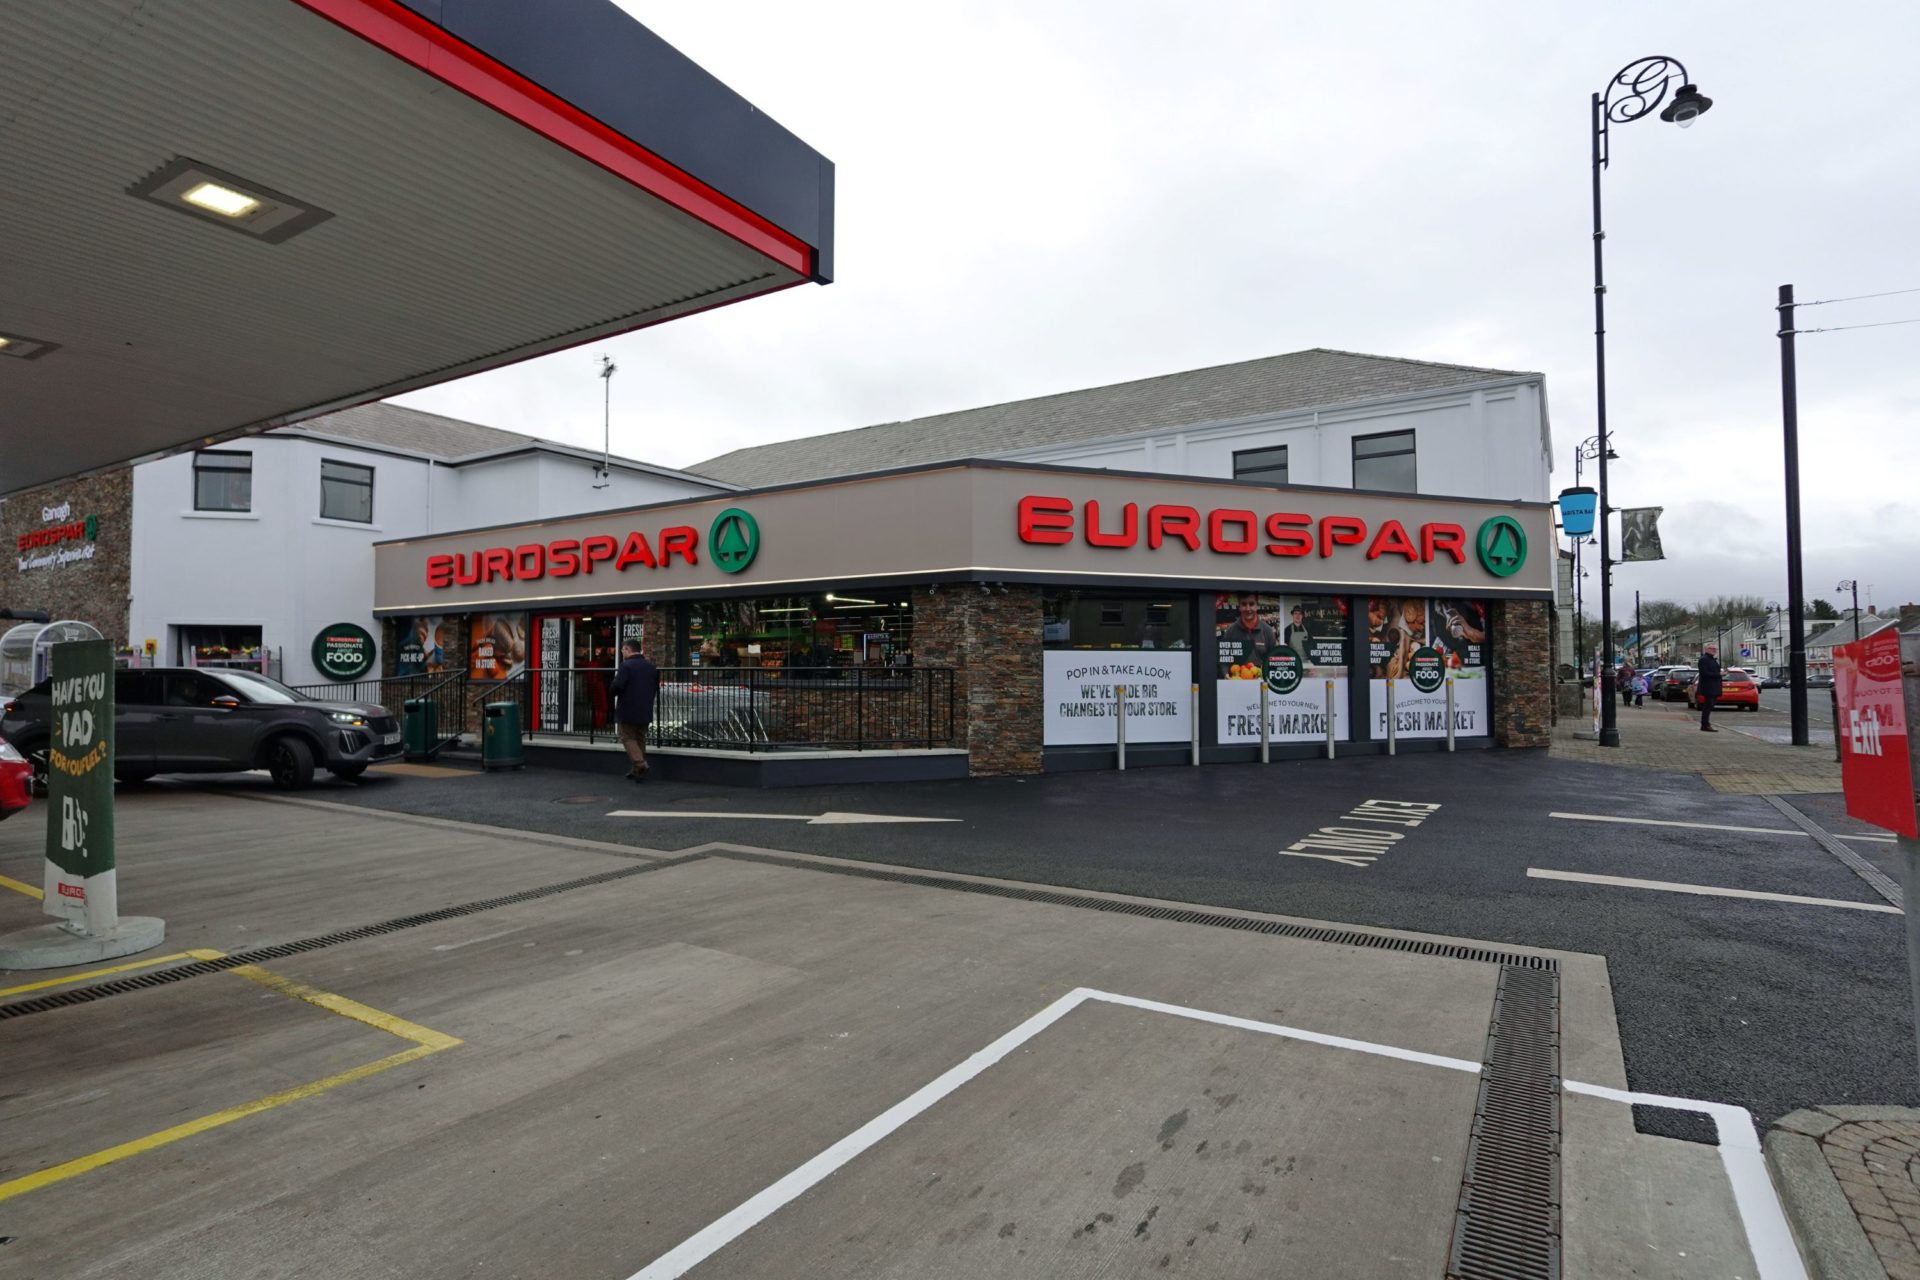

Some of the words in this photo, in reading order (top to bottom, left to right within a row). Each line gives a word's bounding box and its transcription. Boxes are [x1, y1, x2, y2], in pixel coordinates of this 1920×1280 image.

[17, 520, 85, 551] EUROSPAR
[1017, 495, 1466, 565] EUROSPAR
[426, 526, 699, 588] EUROSPAR
[623, 624, 643, 637] FRESH
[326, 652, 363, 663] FOOD
[1067, 667, 1088, 680] POP
[1090, 666, 1100, 676] IN
[1102, 666, 1109, 675] &
[1110, 665, 1134, 675] TAKE
[1137, 666, 1143, 675] A
[1144, 667, 1172, 680] LOOK
[1269, 671, 1296, 680] FOOD
[1415, 671, 1439, 679] FOOD
[51, 677, 82, 706] HAVE
[83, 672, 105, 702] YOU
[1081, 684, 1111, 699] WE'VE
[1142, 684, 1158, 698] BIG
[1060, 702, 1105, 717] CHANGES
[1148, 701, 1177, 716] STORE
[1305, 702, 1319, 710] NEW
[1395, 698, 1423, 709] WELCOME
[1280, 713, 1337, 735] MARKE
[1379, 712, 1421, 732] FESH
[1424, 711, 1475, 731] MAKET
[1339, 799, 1442, 827] EXIT
[1278, 827, 1405, 867] ONLY
